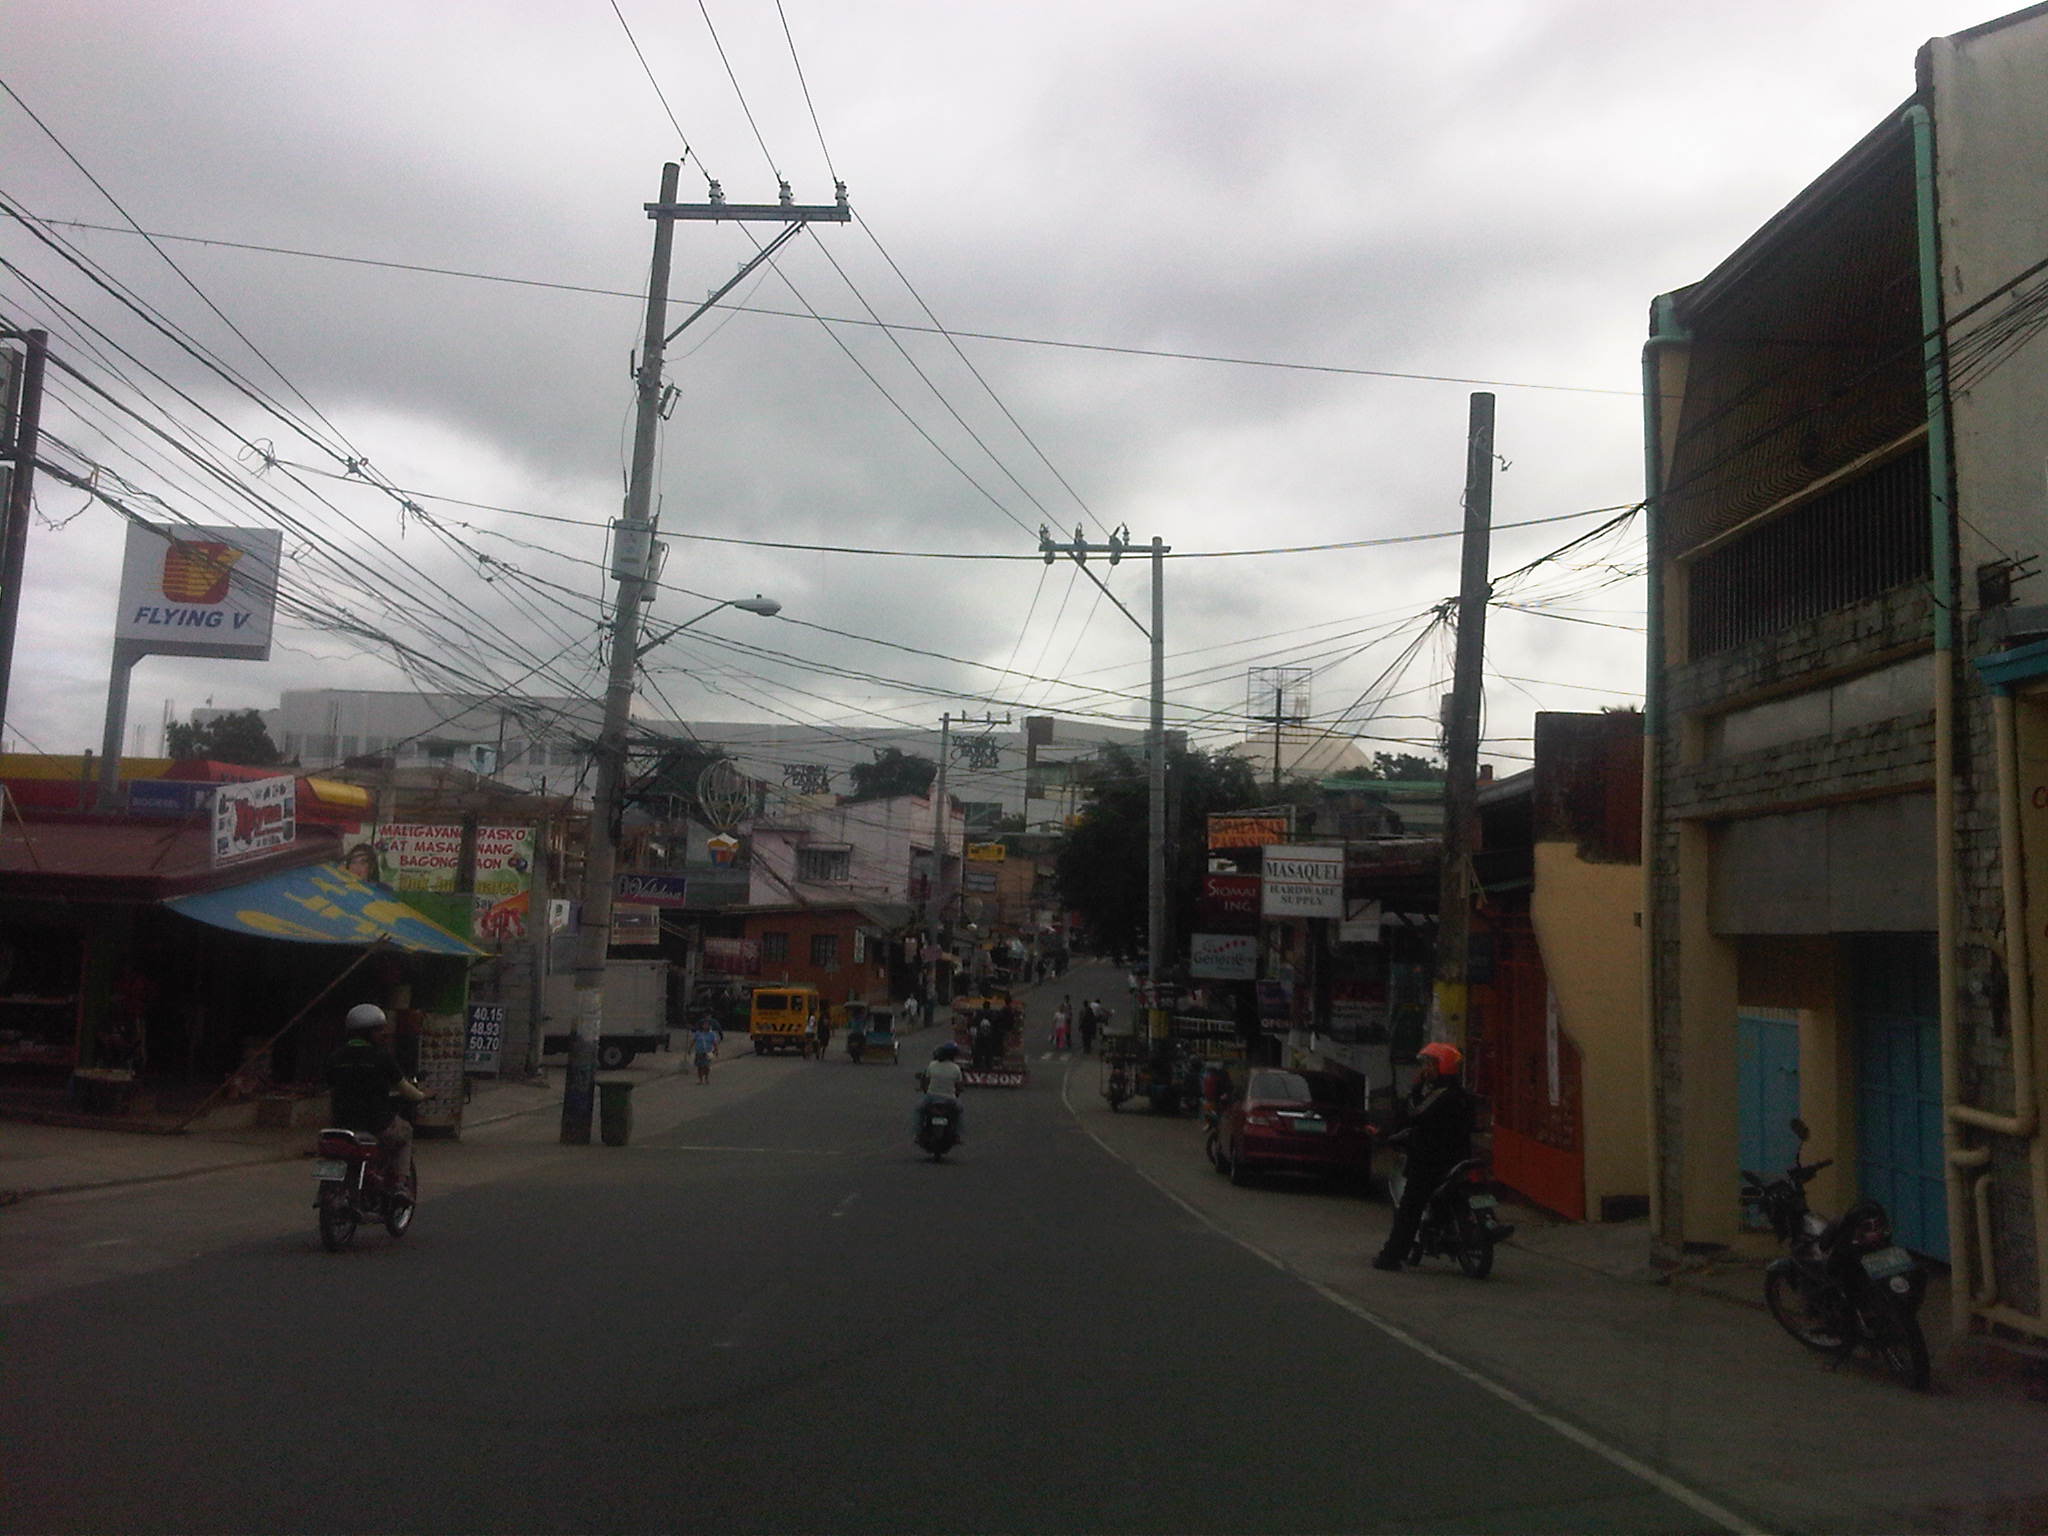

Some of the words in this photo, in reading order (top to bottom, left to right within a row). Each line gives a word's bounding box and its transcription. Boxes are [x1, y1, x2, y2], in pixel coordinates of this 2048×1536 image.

[134, 607, 223, 628] FLYING
[233, 612, 252, 630] V
[380, 825, 462, 839] MALIGAYAN
[478, 828, 525, 841] PASKO
[390, 840, 408, 851] AT
[1266, 862, 1339, 881] MASAQUEL
[1270, 885, 1335, 897] HARDWARE
[1281, 896, 1322, 906] SUPPLY
[473, 1007, 503, 1021] 40.15
[470, 1022, 499, 1036] 48.93
[469, 1036, 499, 1050] 50.70
